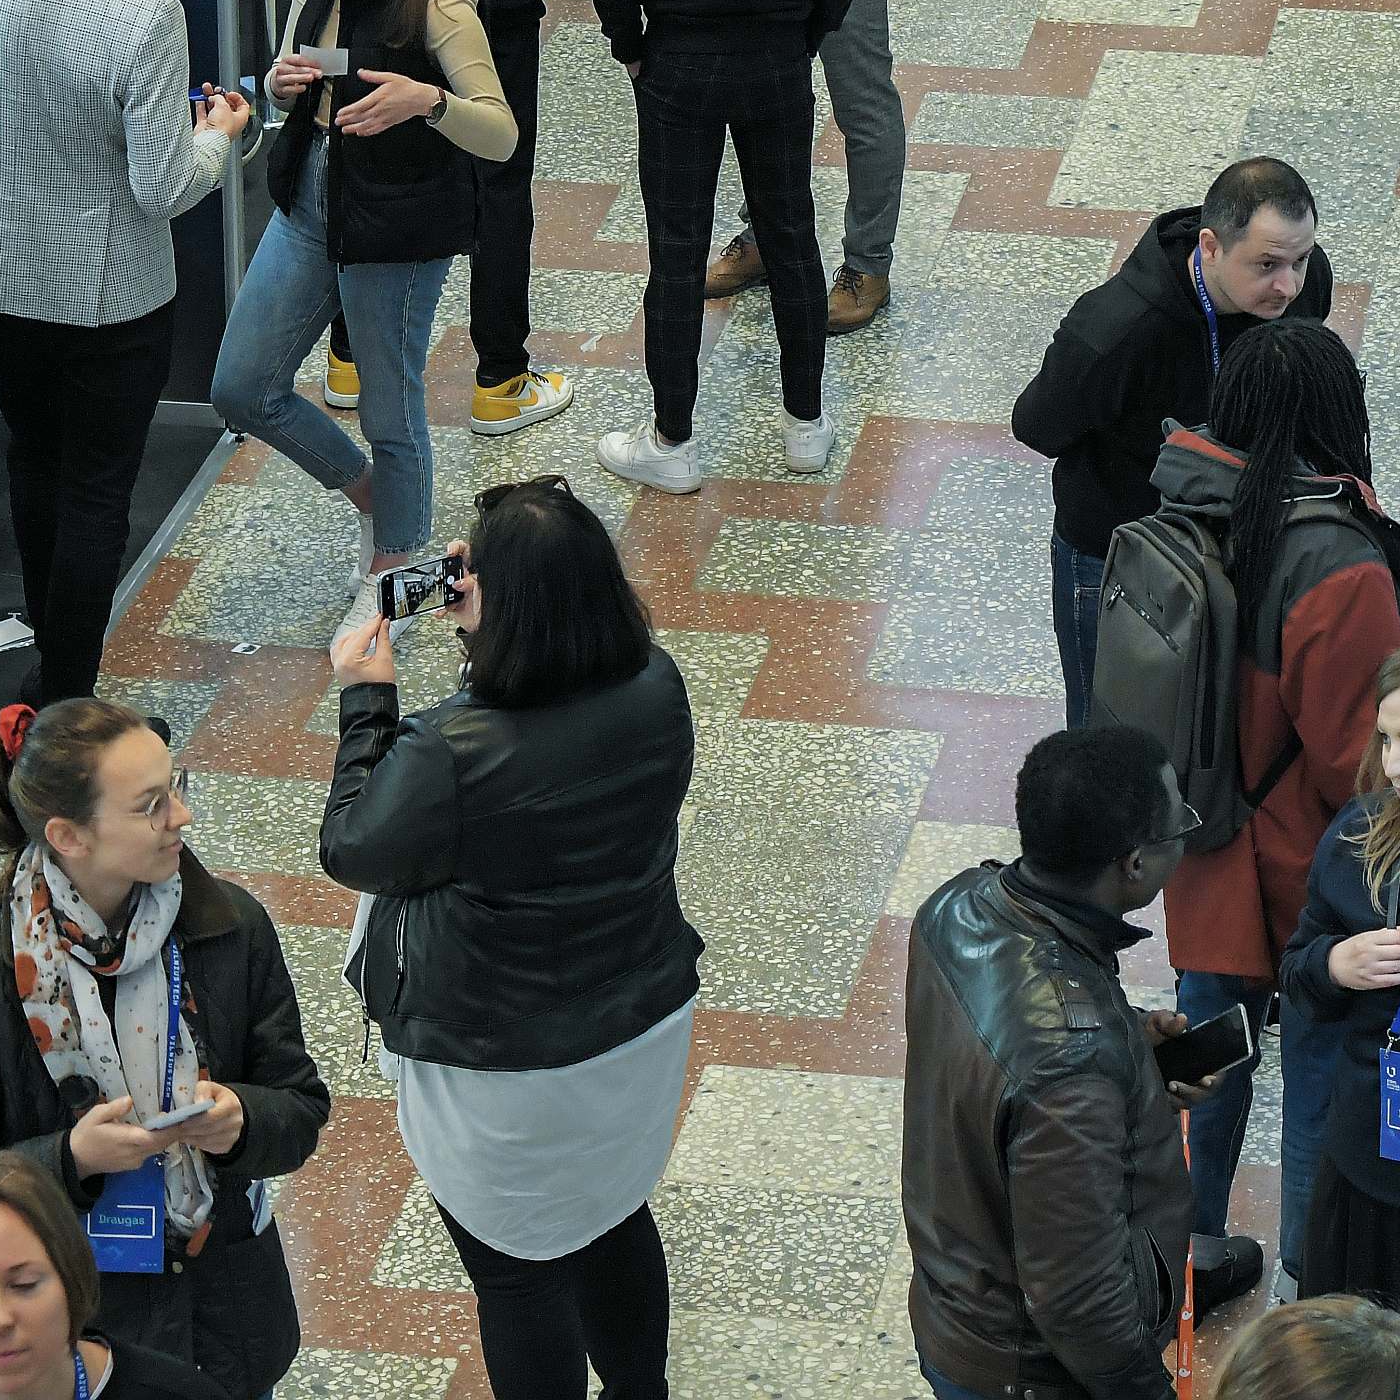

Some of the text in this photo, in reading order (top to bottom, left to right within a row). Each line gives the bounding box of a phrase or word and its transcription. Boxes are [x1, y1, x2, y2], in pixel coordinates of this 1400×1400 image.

[172, 944, 181, 1006] VILNIUS TECH
[98, 1213, 145, 1228] Draugas
